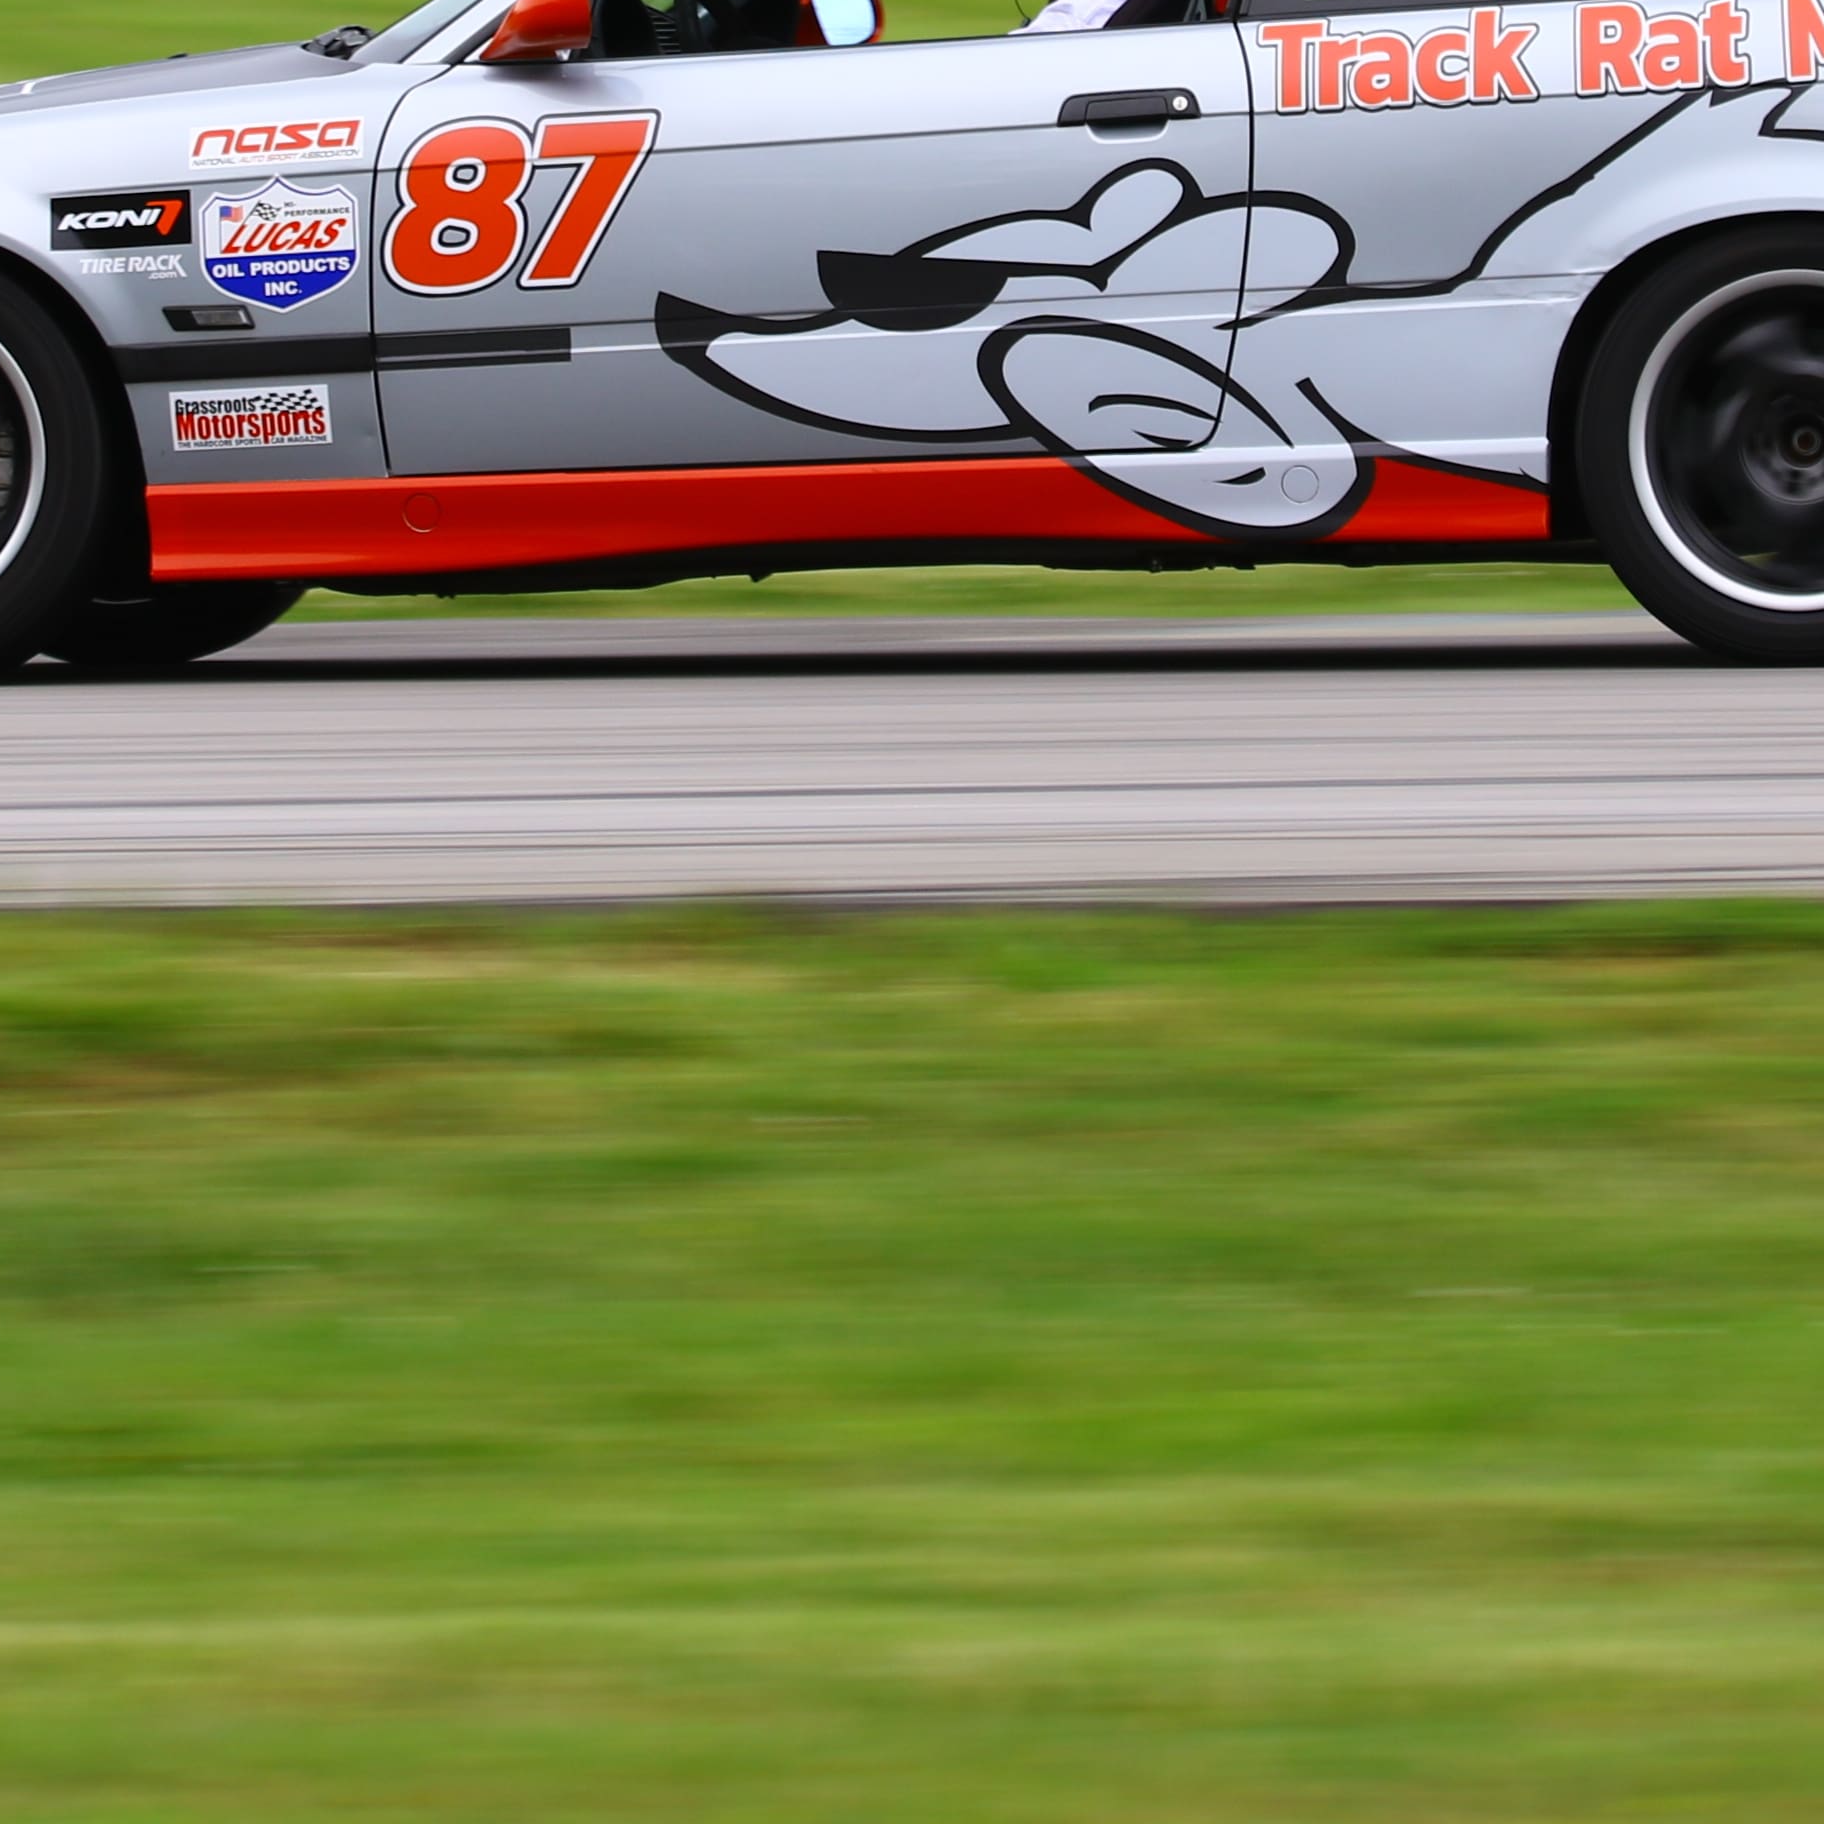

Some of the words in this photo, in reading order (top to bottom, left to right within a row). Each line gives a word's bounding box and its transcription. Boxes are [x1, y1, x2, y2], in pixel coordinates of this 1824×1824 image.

[1258, 6, 1539, 114] Track
[284, 206, 351, 217] PERFORMANCE
[381, 108, 662, 297] 87
[57, 208, 162, 231] KONI
[220, 218, 348, 255] LUCAS
[80, 256, 126, 274] TIRE
[128, 254, 187, 277] RACK
[212, 263, 244, 278] OIL
[250, 256, 351, 276] PRODUCTS
[264, 280, 303, 297] INC.
[175, 397, 256, 415] Grassroots
[176, 409, 326, 444] Motorsports
[194, 439, 232, 448] HARDCORE
[235, 437, 262, 446] SPORTS
[271, 436, 285, 444] CAR
[287, 434, 328, 443] MAGAZINE
